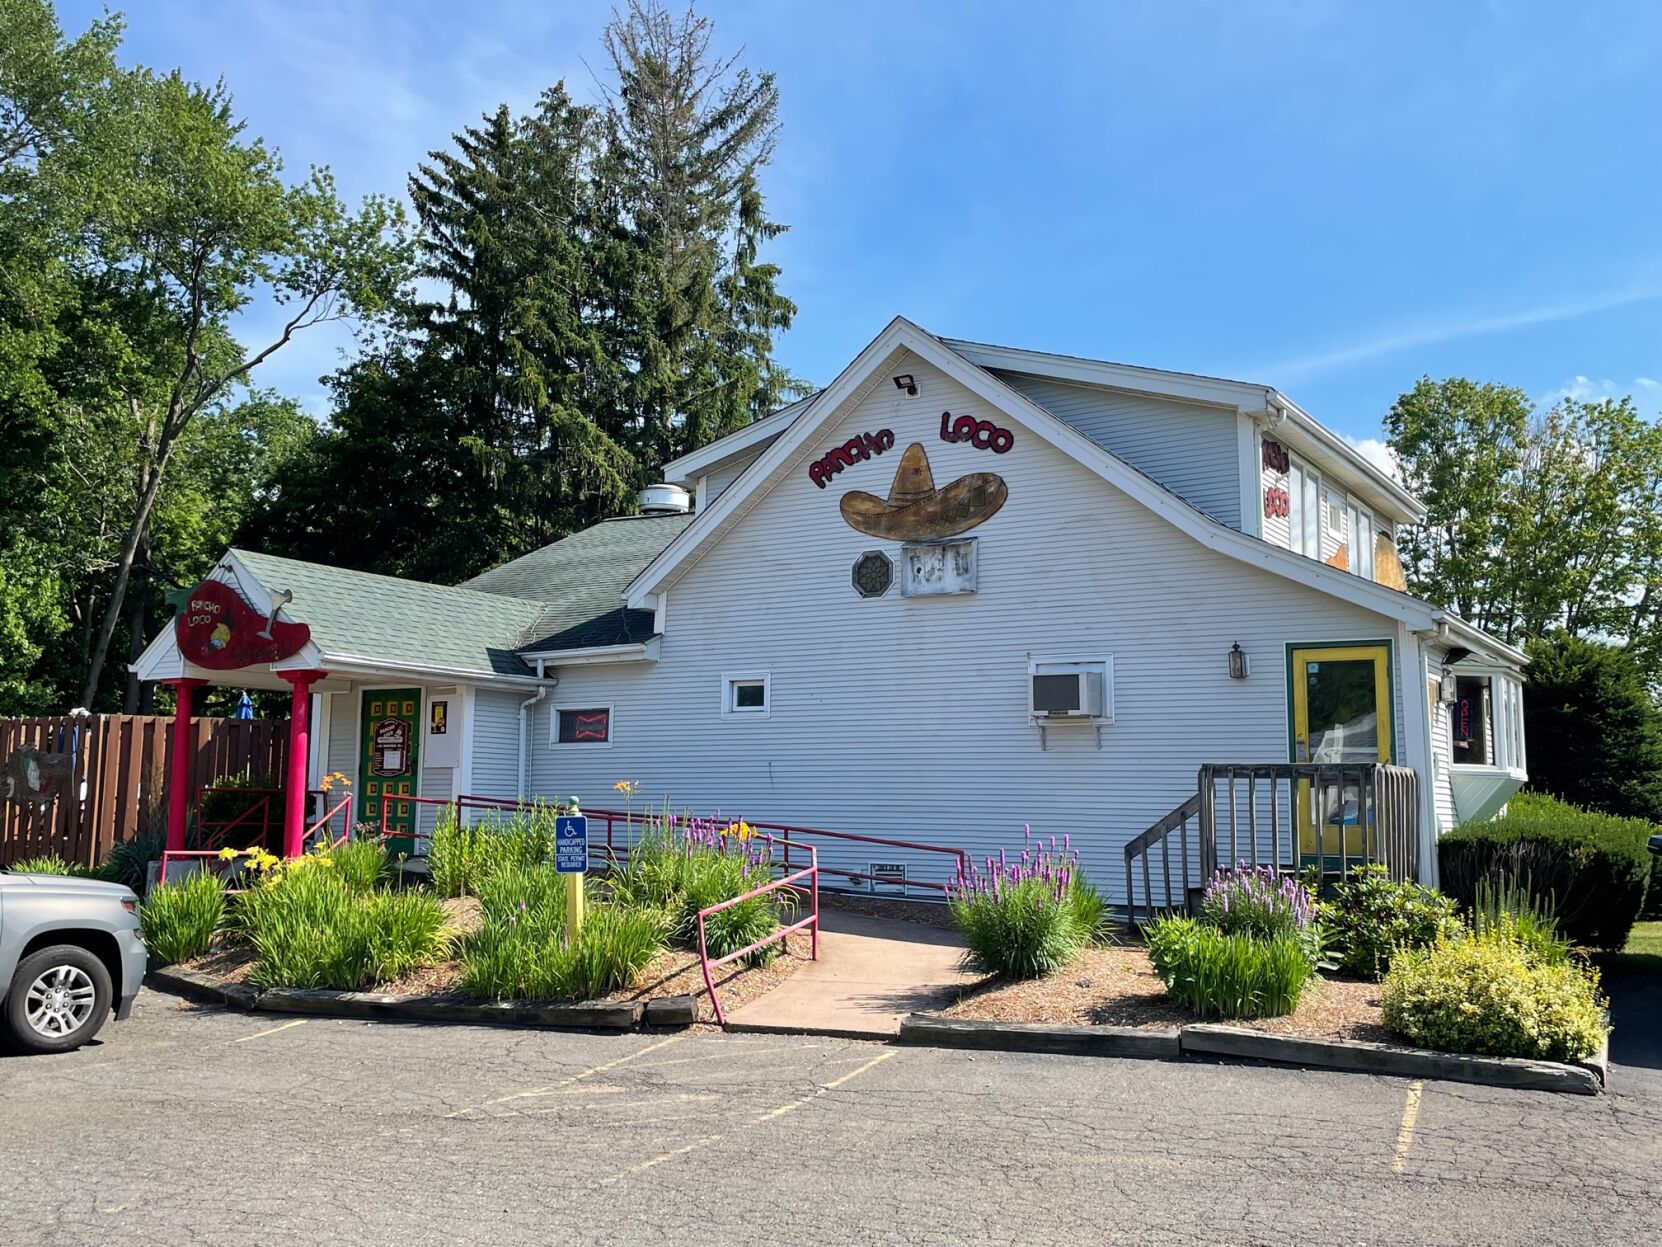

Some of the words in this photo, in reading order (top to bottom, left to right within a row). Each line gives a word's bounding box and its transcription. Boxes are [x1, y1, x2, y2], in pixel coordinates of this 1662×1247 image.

[808, 428, 895, 490] PANCHO
[940, 411, 1014, 454] LOCO
[191, 600, 221, 614] PANCHO
[188, 615, 212, 627] LOCO
[1460, 700, 1470, 738] OPEN
[557, 838, 586, 847] HANDICAPPED
[560, 846, 583, 854] PARKING
